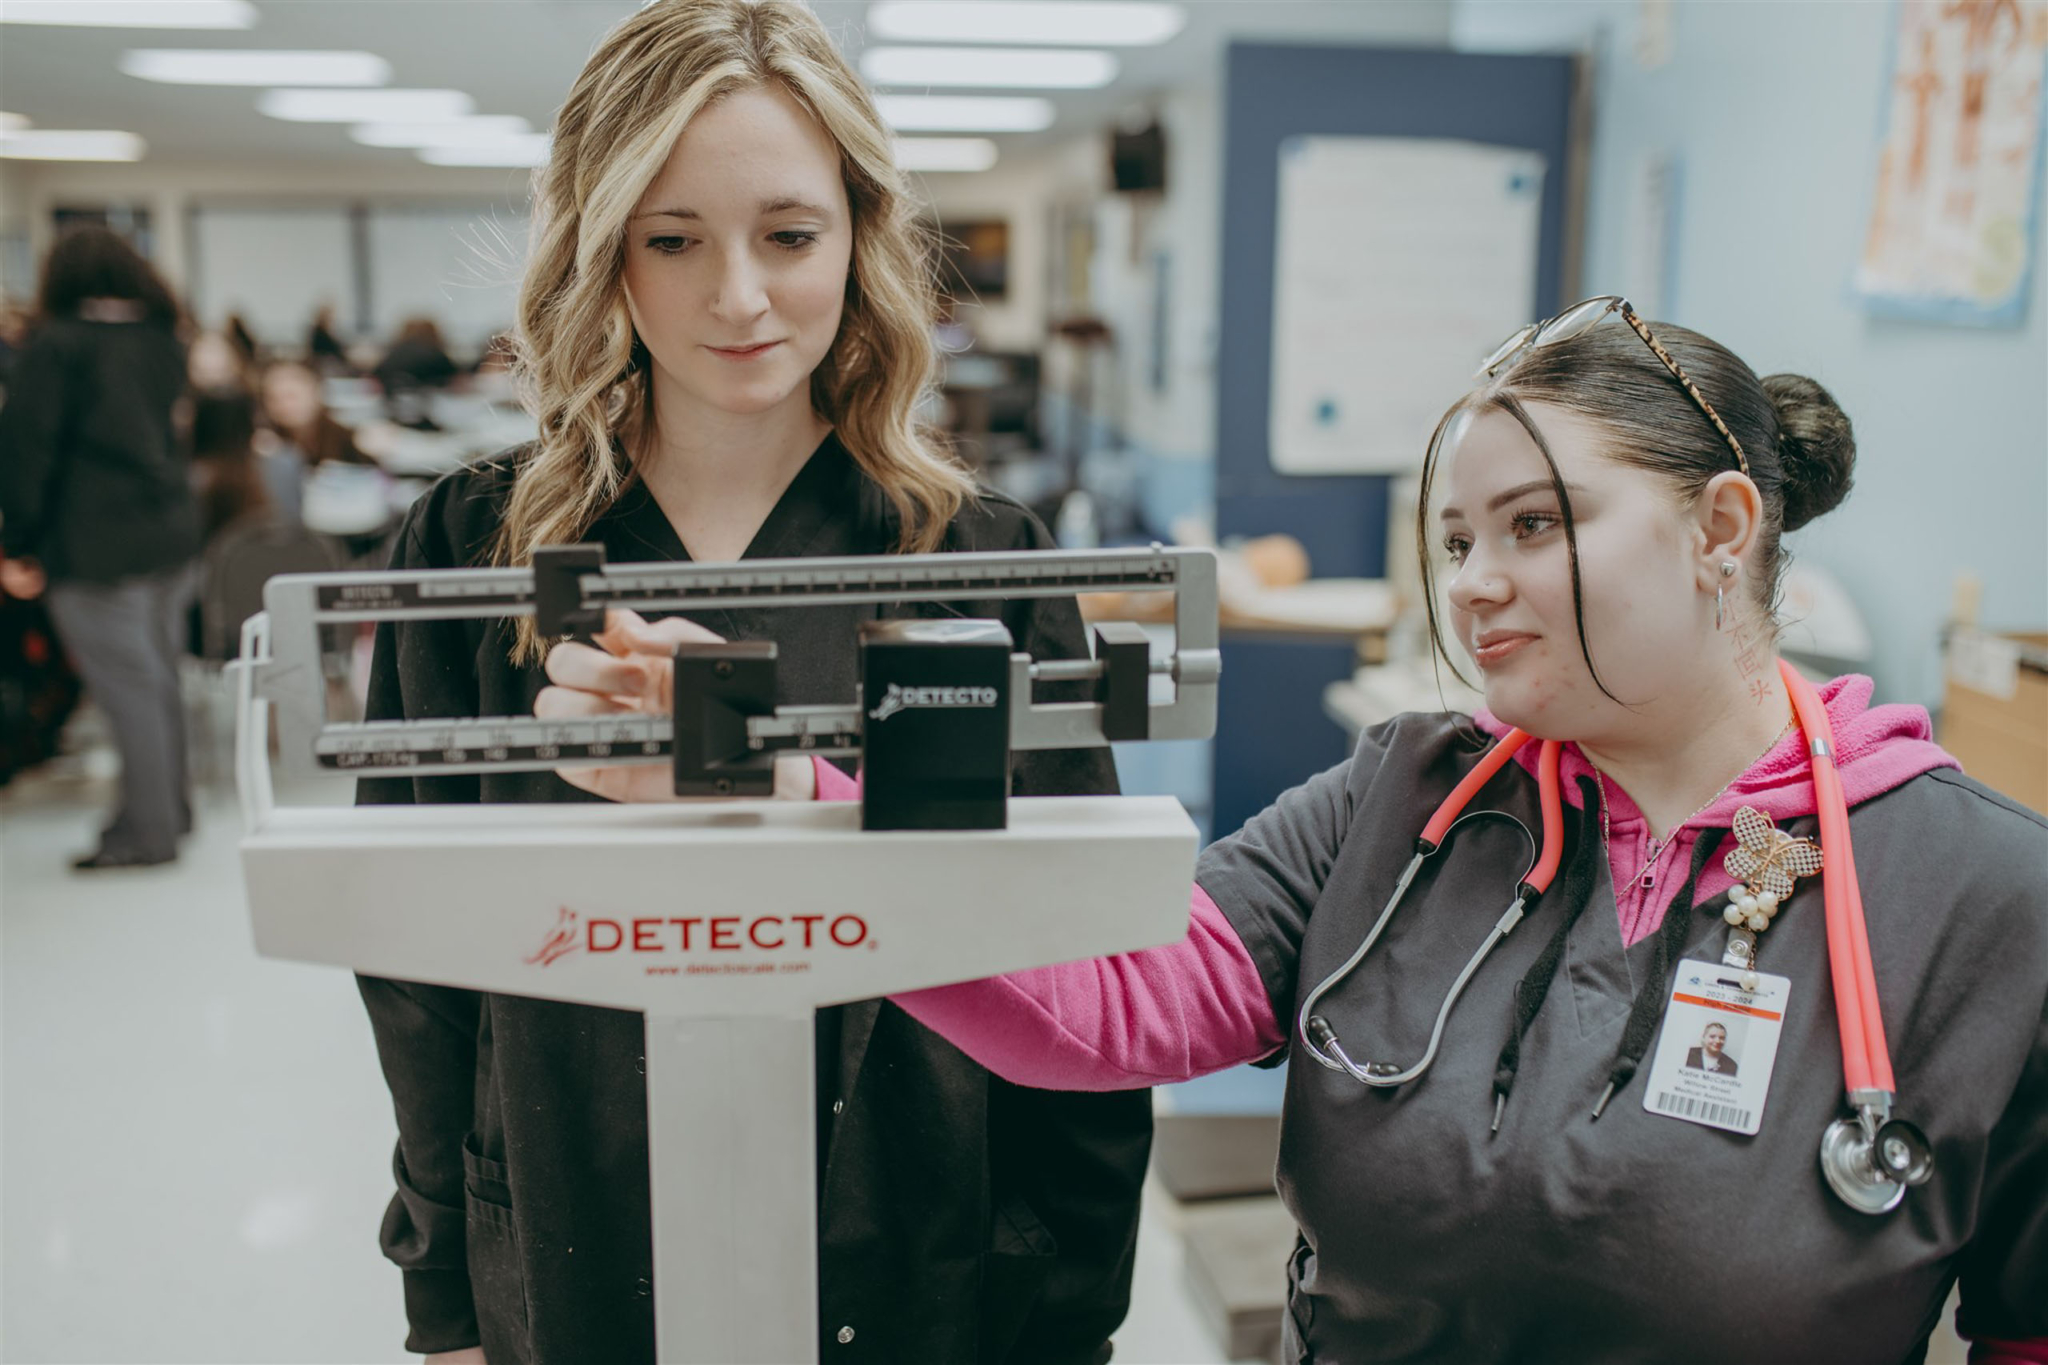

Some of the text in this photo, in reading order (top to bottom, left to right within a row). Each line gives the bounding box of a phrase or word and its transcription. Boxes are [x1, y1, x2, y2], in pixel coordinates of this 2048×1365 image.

[902, 687, 998, 704] DETECTO
[587, 914, 868, 952] DETECTO
[1706, 989, 1726, 999] 2023
[1733, 995, 1753, 1005] 2024
